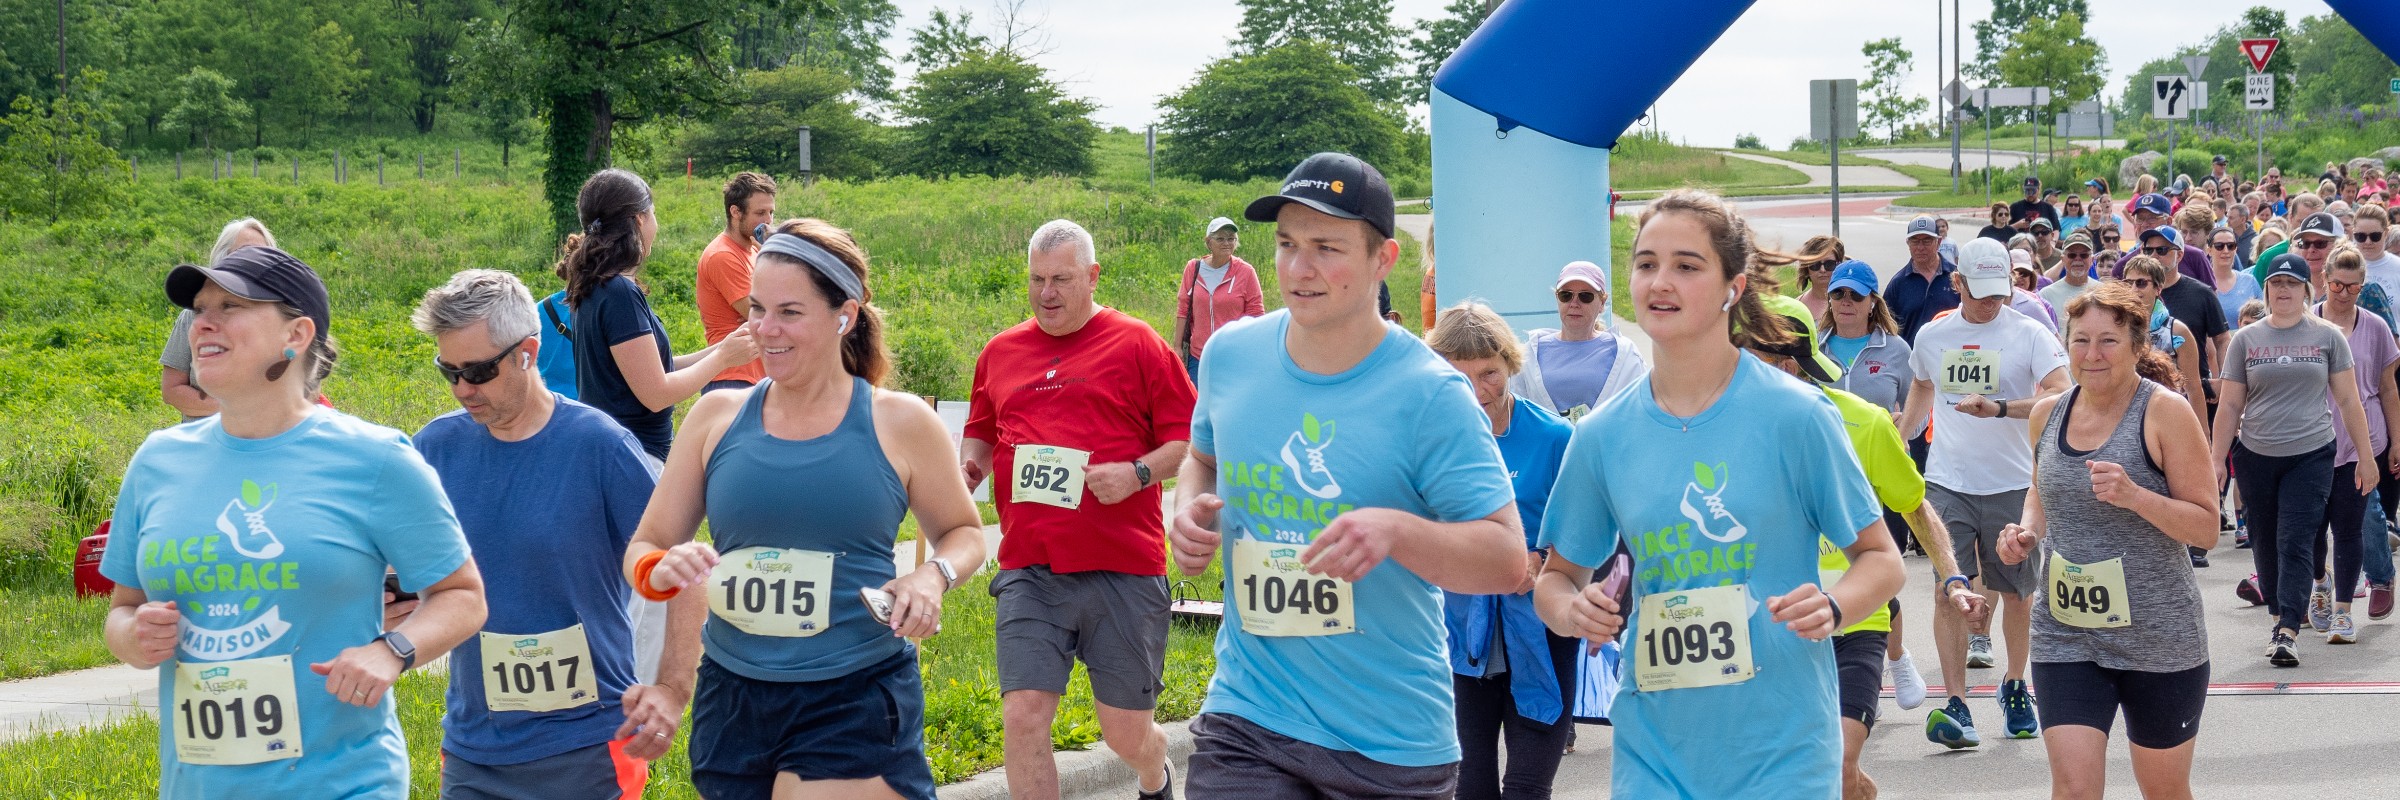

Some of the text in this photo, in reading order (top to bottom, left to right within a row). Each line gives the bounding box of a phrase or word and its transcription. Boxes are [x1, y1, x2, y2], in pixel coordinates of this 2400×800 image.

[2249, 77, 2269, 86] ONE
[2249, 87, 2270, 96] WAY
[2248, 344, 2321, 358] MADISON
[1946, 364, 1991, 383] 1041
[1020, 463, 1070, 493] 952
[1223, 460, 1285, 491] RACE
[144, 535, 220, 569] RACE
[1275, 529, 1305, 543] 2024
[175, 562, 300, 595] AGRACE
[1661, 543, 1757, 582] AGRACE
[208, 603, 239, 617] 2024
[720, 575, 815, 617] 1015
[1243, 574, 1339, 615] 1046
[2056, 579, 2110, 614] 949
[182, 623, 272, 653] MADISON
[1644, 621, 1735, 667] 1093
[492, 655, 580, 694] 1017
[180, 694, 283, 740] 1019
